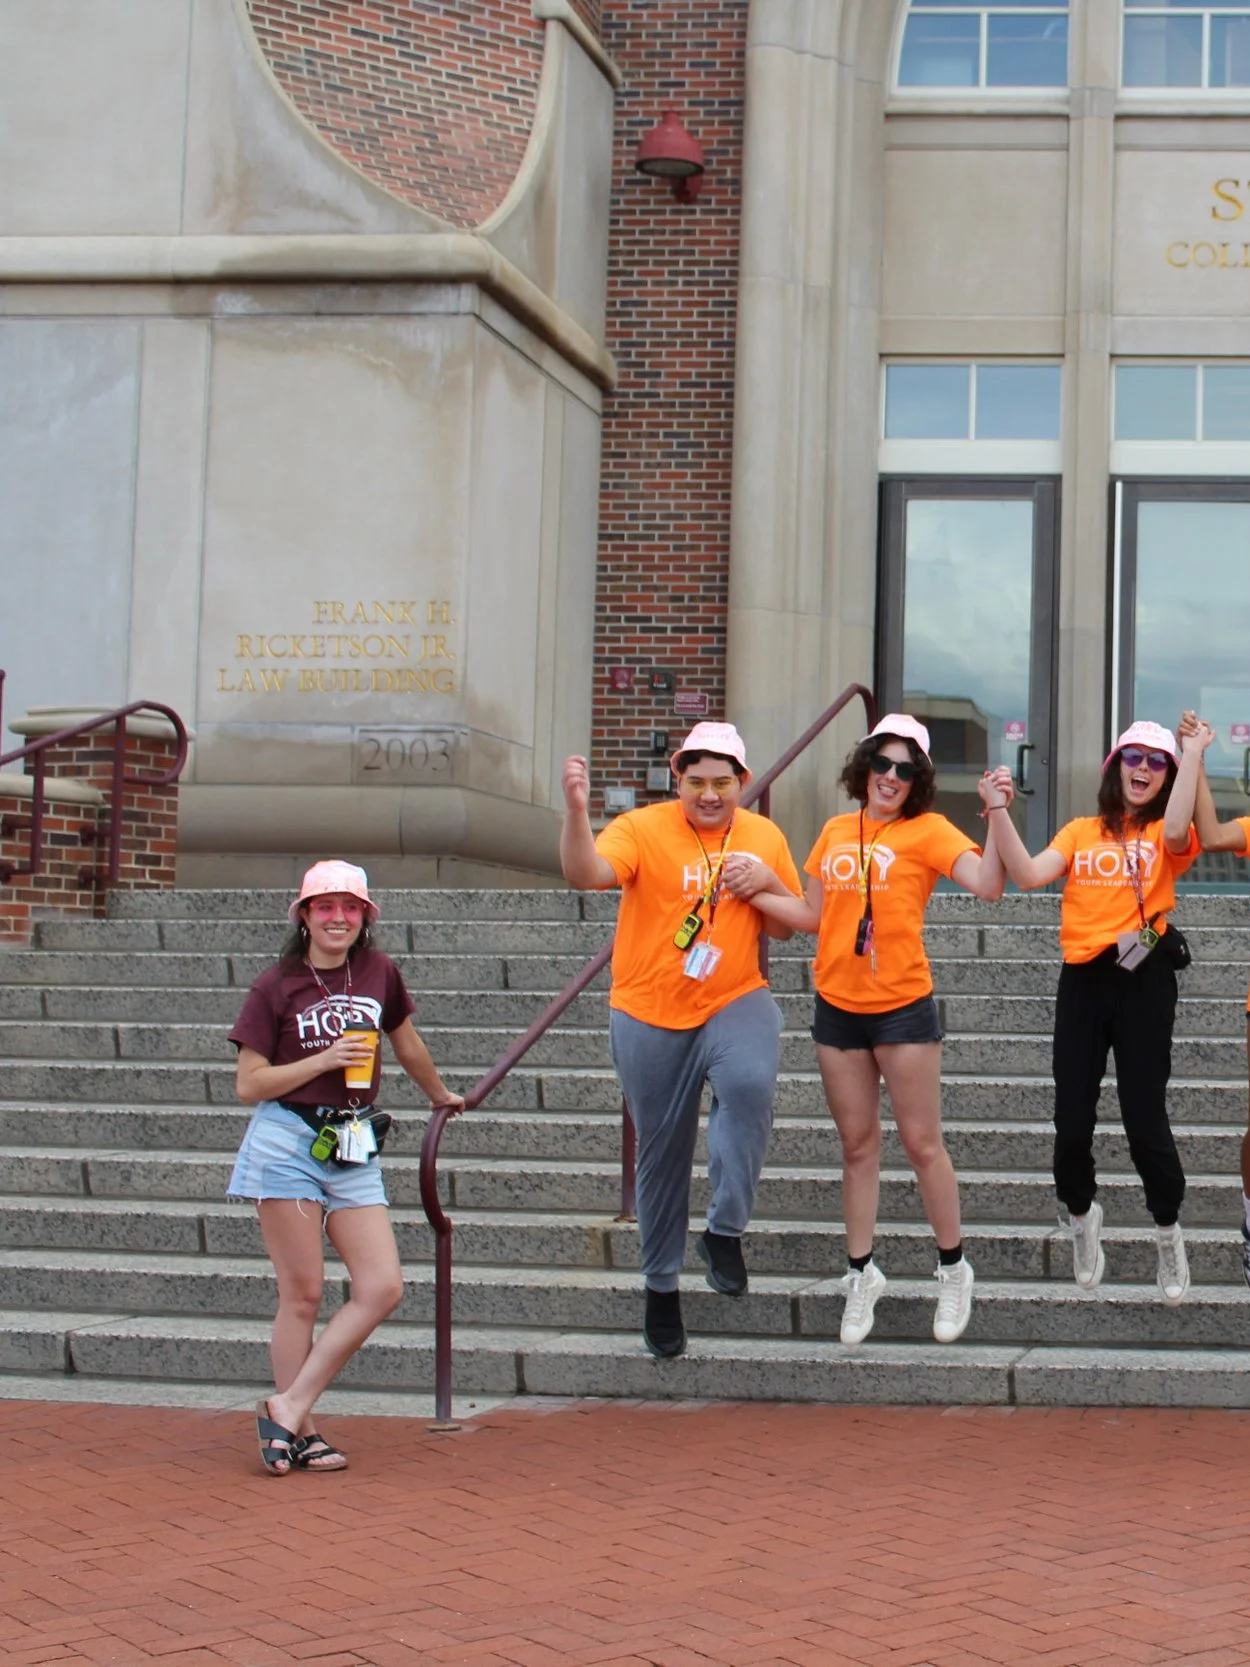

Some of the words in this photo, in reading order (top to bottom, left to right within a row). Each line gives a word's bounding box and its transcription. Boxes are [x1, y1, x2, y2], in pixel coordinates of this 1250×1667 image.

[312, 600, 417, 625] FRANK
[427, 600, 457, 625] H.
[235, 634, 411, 659] RICKETSON
[418, 634, 457, 662] JR.
[217, 668, 290, 693] LAW
[297, 668, 456, 694] BUILDING
[363, 738, 450, 771] 2003
[1075, 840, 1158, 877] HOBY
[1075, 879, 1101, 887] YOUTH
[301, 1040, 331, 1049] YOUTH
